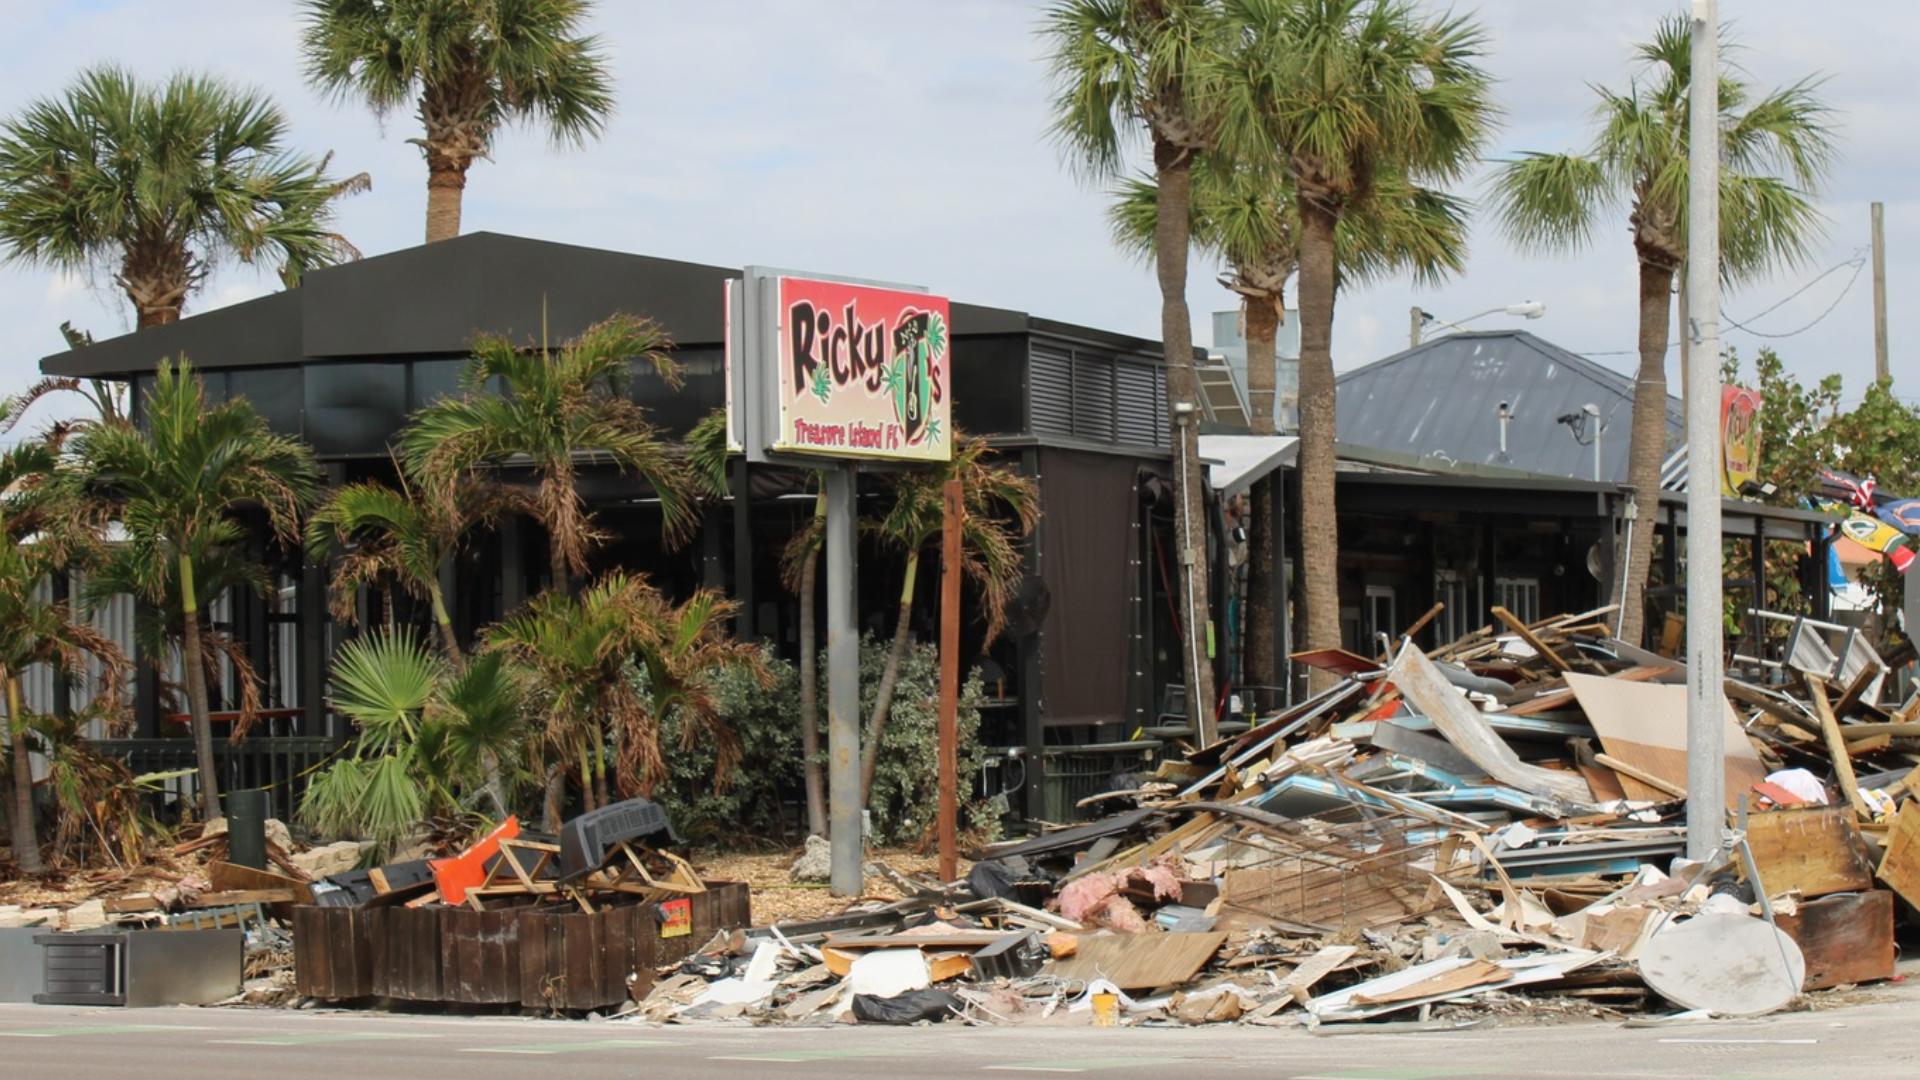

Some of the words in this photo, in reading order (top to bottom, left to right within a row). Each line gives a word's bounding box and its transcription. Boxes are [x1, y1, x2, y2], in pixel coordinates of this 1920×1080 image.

[790, 301, 885, 397] Ricky
[794, 418, 845, 445] Treasure
[848, 421, 883, 449] Island
